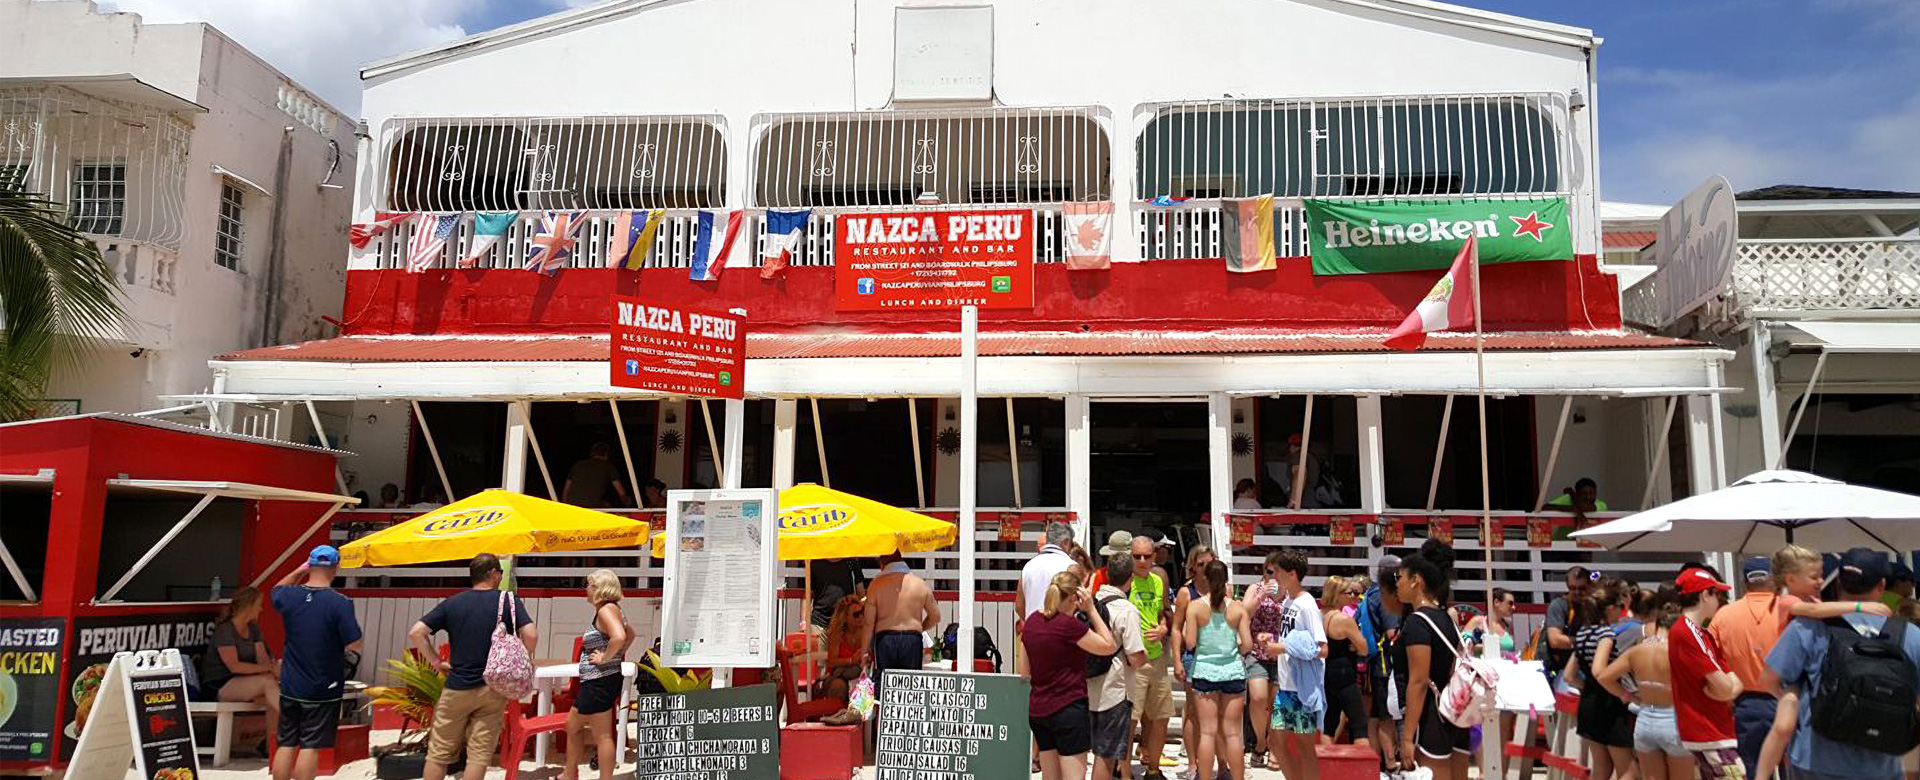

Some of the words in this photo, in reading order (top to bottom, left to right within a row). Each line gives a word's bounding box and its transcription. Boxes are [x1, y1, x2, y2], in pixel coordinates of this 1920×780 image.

[846, 216, 940, 244] NAZCA
[948, 214, 1023, 242] PERU
[1322, 217, 1499, 249] Heineken
[854, 246, 944, 256] RESTAURANT
[952, 245, 979, 254] AND
[987, 245, 1014, 253] BAR
[947, 298, 986, 306] DINNER
[618, 302, 684, 334] NAZCA
[689, 313, 736, 340] PERU
[622, 334, 687, 348] RESTAURANT
[693, 343, 710, 351] AND
[716, 346, 732, 354] BAR
[0, 628, 60, 646] ASTED
[78, 623, 172, 656] PERUVIAN
[174, 621, 216, 648] ROAS
[0, 652, 56, 674] CKEN
[886, 674, 910, 689] LOMO
[912, 676, 956, 691] SALTADO
[961, 678, 974, 692] 22
[640, 697, 661, 710] FREE
[667, 695, 685, 709] WIFI
[884, 690, 925, 705] CEVICHE
[930, 692, 970, 708] CLASICO
[975, 695, 986, 709] 13
[640, 712, 667, 726] HAPPY
[670, 710, 694, 725] HOUR
[723, 709, 729, 723] 2
[731, 707, 761, 722] BEERS
[765, 706, 772, 720] 4
[883, 706, 926, 720] CEVICHE
[930, 708, 959, 722] MIXTO
[963, 709, 974, 723] 15
[646, 726, 680, 741] FROZEN
[687, 726, 694, 740] 6
[882, 721, 907, 735] PAPA
[909, 722, 917, 736] A
[920, 722, 933, 736] LA
[939, 723, 993, 739] HUANCAINA
[1000, 726, 1007, 740] 9
[762, 739, 769, 753] 3
[881, 736, 904, 751] TRIO
[907, 737, 919, 752] DE
[923, 738, 961, 754] CAUSAS
[967, 740, 978, 755] 16
[640, 758, 686, 773] HOMEMADE
[689, 756, 736, 771] LEMONADE
[740, 756, 746, 770] 3
[917, 754, 949, 770] SALAD
[955, 757, 967, 771] 16
[879, 768, 897, 780] AJI
